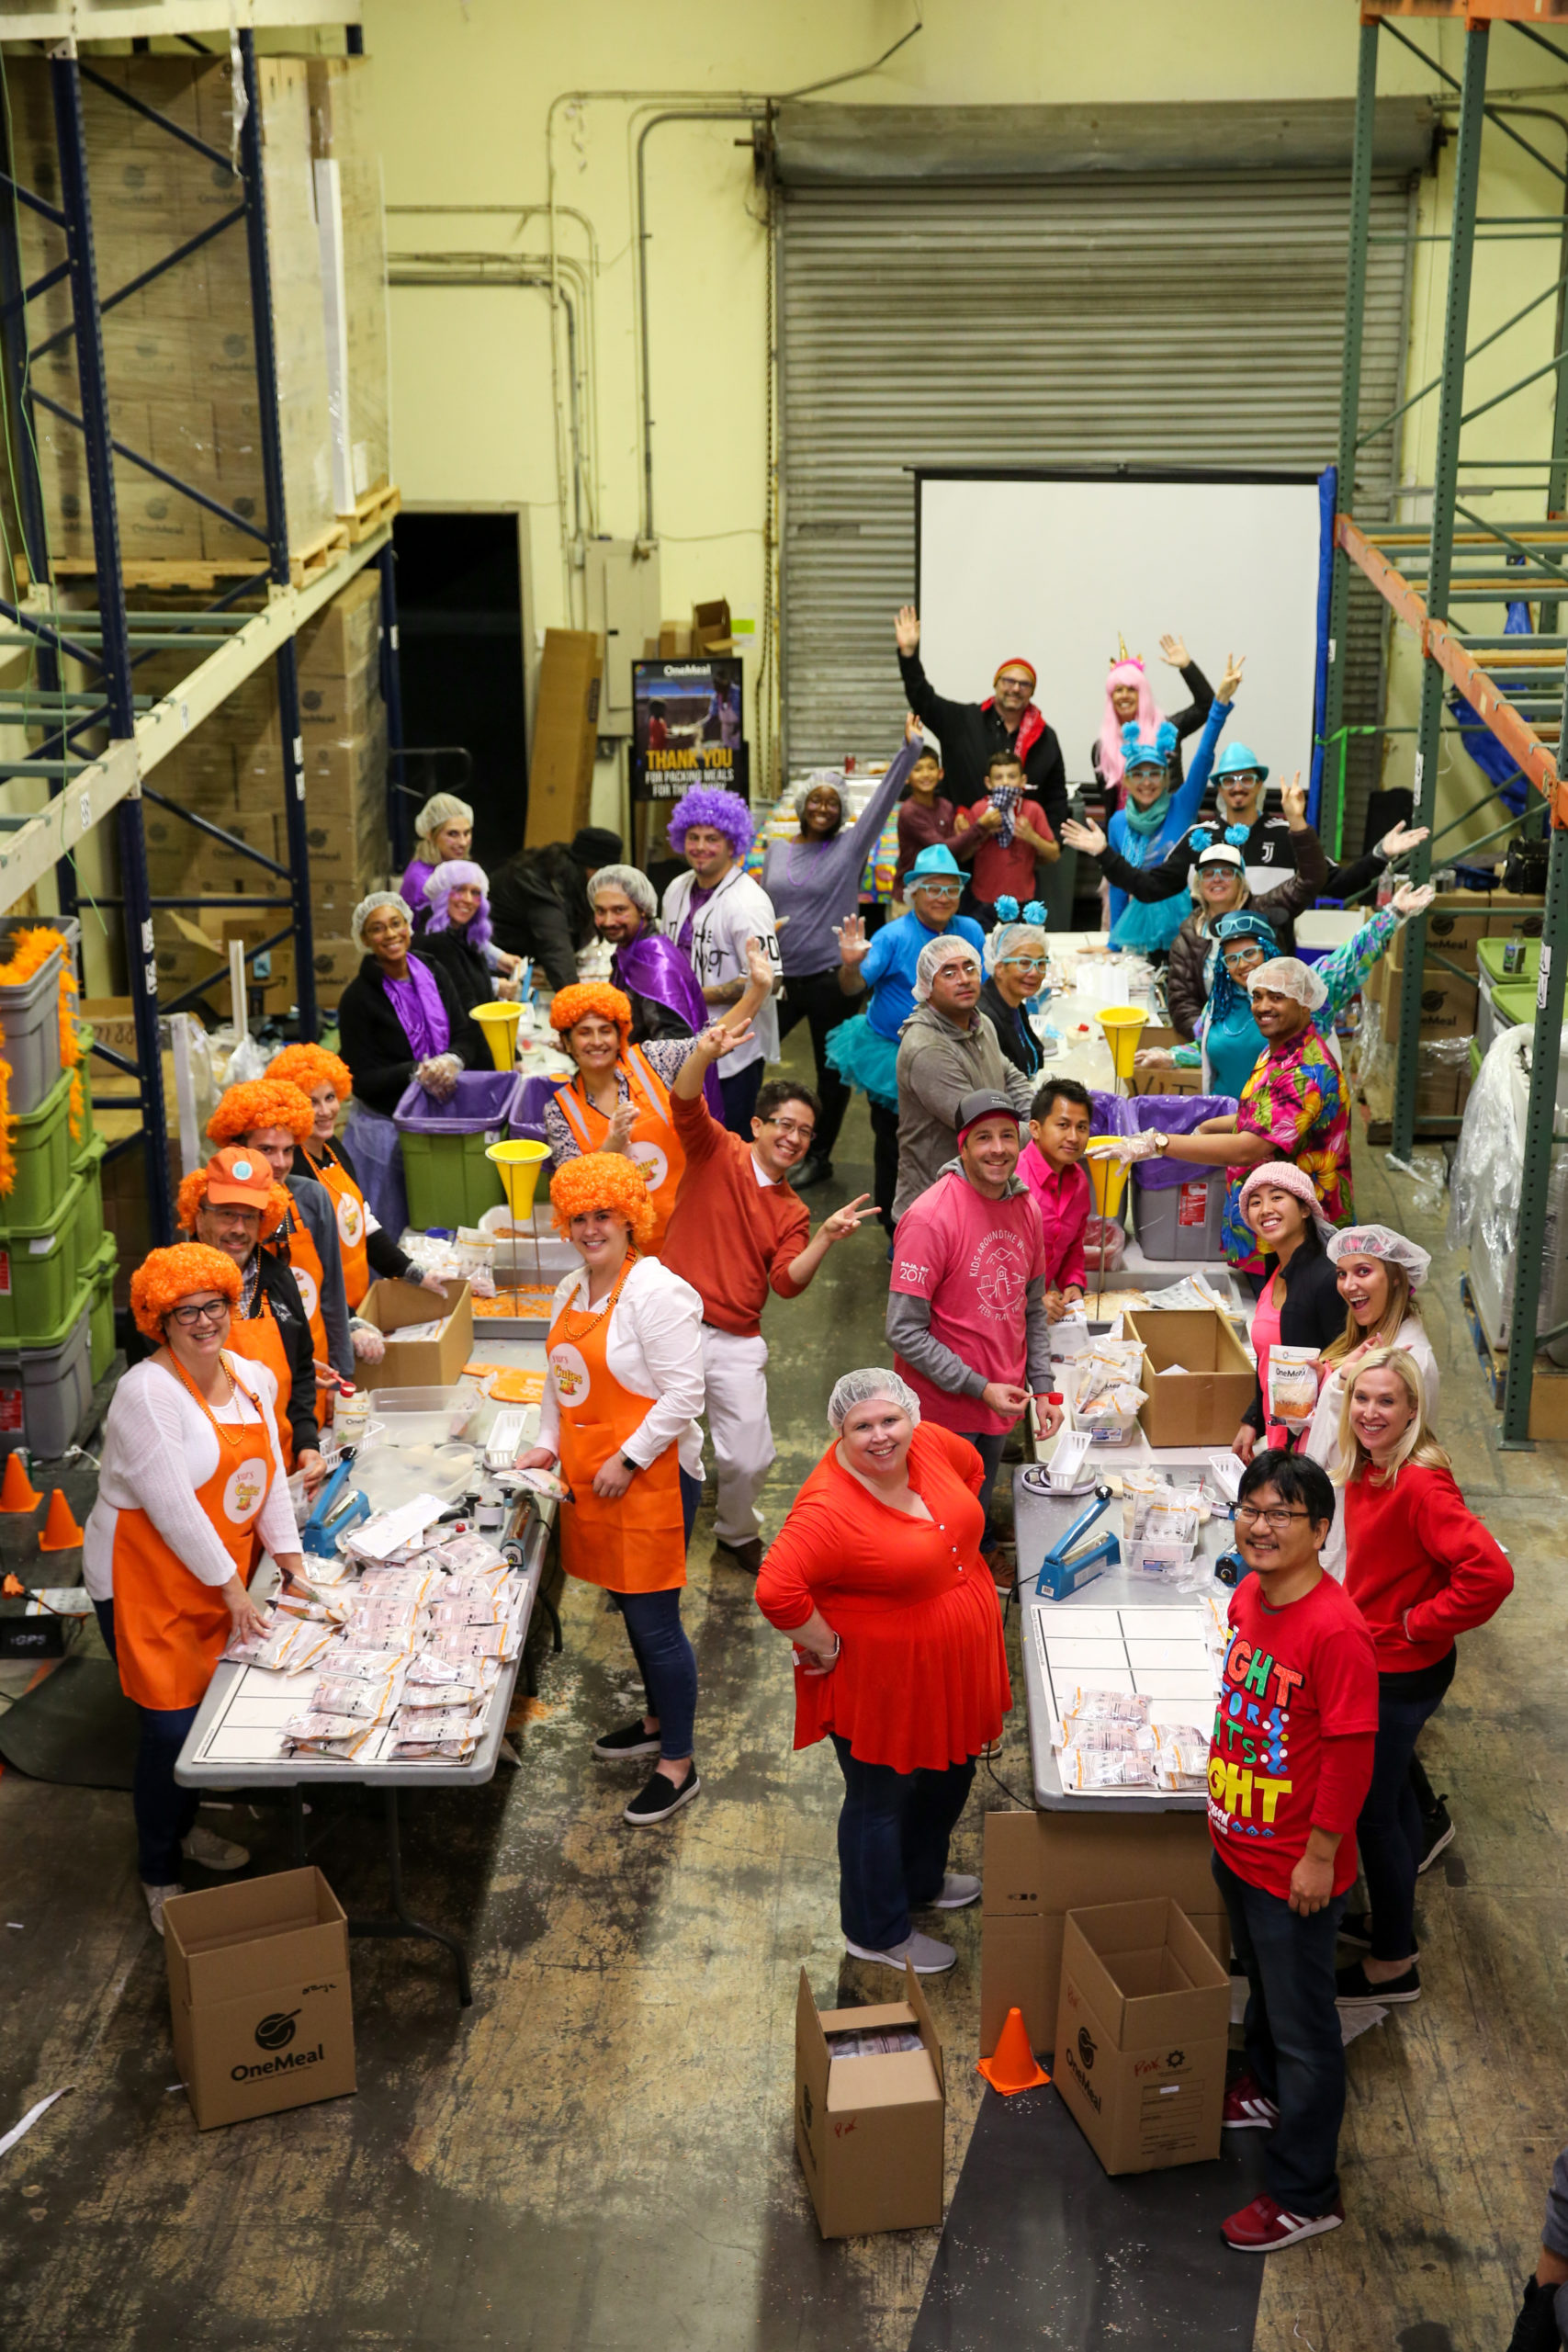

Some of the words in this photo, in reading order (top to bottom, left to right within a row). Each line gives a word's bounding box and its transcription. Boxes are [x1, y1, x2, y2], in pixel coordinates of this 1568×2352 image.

[663, 663, 711, 677] OneMeal
[646, 749, 699, 771] THANK
[702, 747, 733, 769] YOU
[645, 771, 663, 785] FOR
[664, 769, 702, 783] PACKING
[704, 768, 734, 781] MEALS
[652, 783, 671, 797] FOR
[1425, 938, 1468, 950] neMeal
[1421, 1015, 1458, 1027] eMeal
[969, 1255, 982, 1277] KIDS
[977, 1229, 1004, 1256] AROUND
[1004, 1230, 1018, 1244] THE
[977, 1304, 992, 1318] FEED
[1224, 1628, 1305, 1710] IGHT
[1207, 1756, 1292, 1824] GHT
[230, 2042, 324, 2082] OneMeal
[1066, 2047, 1102, 2115] OneMeal
